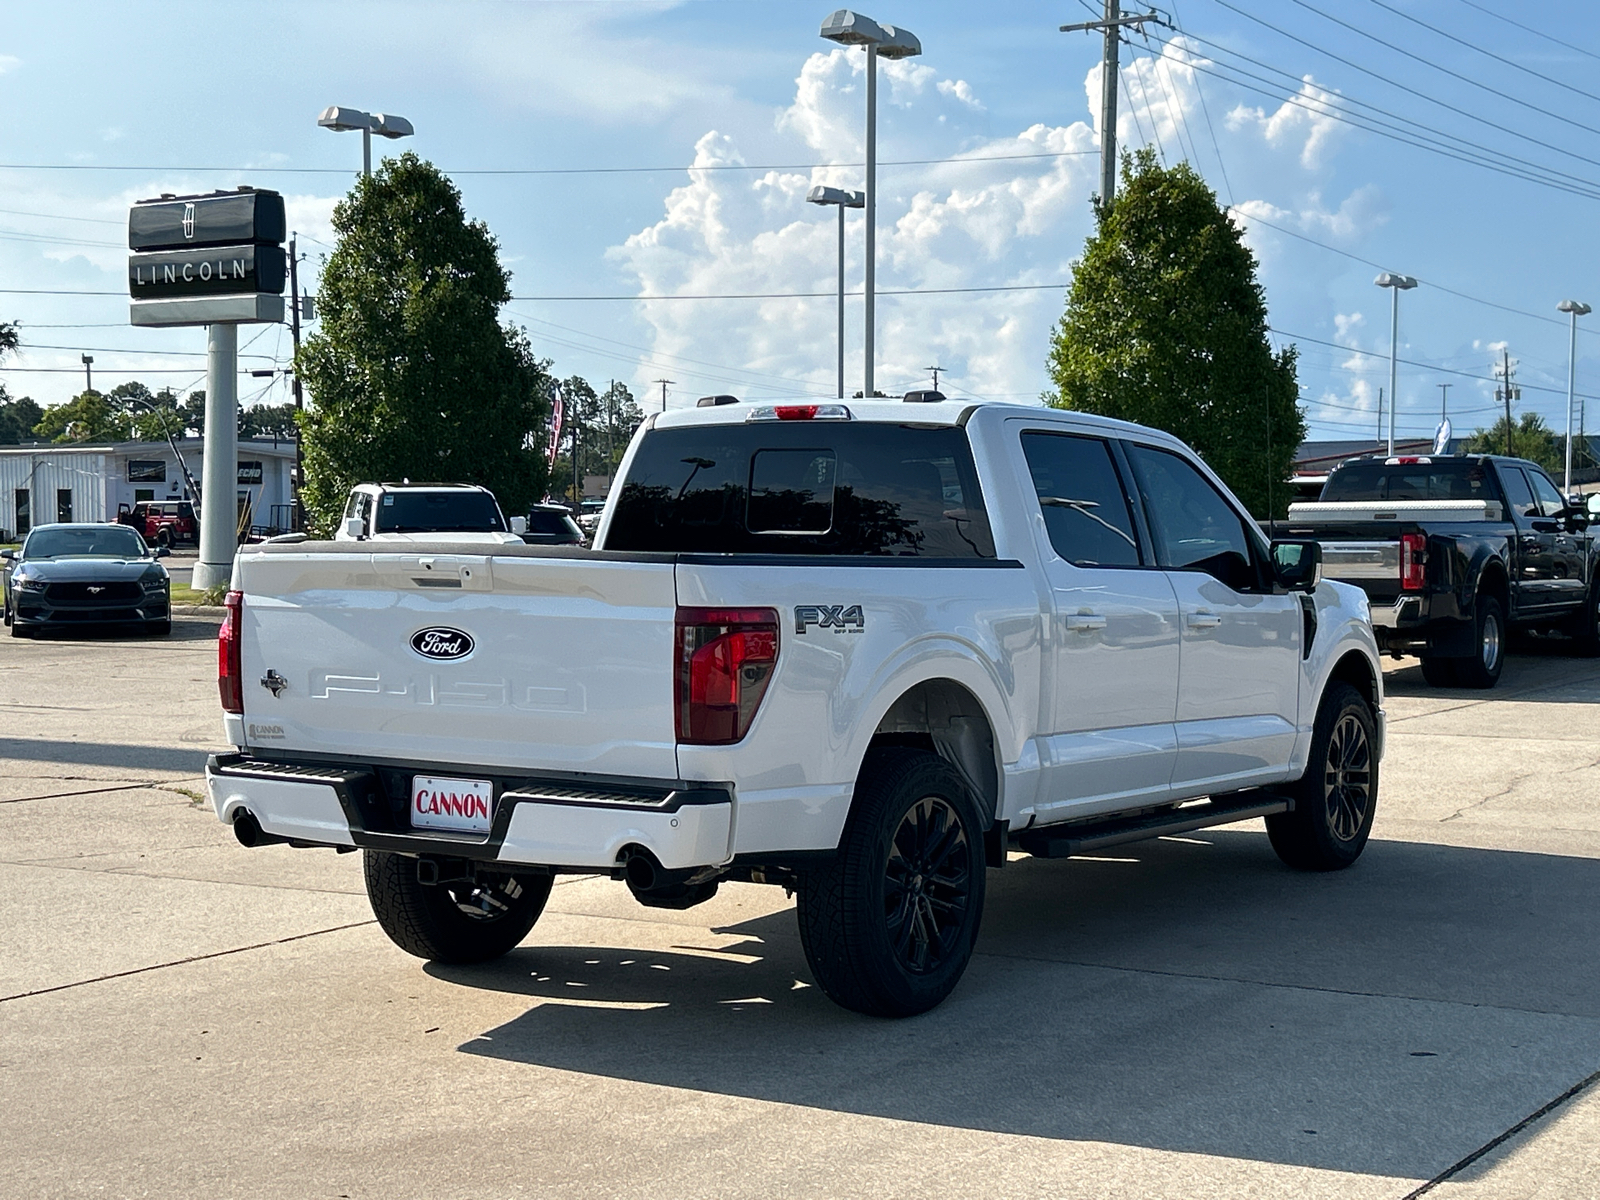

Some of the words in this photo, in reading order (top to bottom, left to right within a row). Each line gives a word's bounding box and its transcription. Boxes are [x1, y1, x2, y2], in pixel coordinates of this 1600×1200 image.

[136, 259, 246, 286] LINCOLN
[793, 604, 865, 635] FX4
[420, 631, 462, 654] Ford
[308, 666, 588, 715] F-150
[255, 725, 285, 734] CANNON
[415, 789, 489, 820] CANNON
